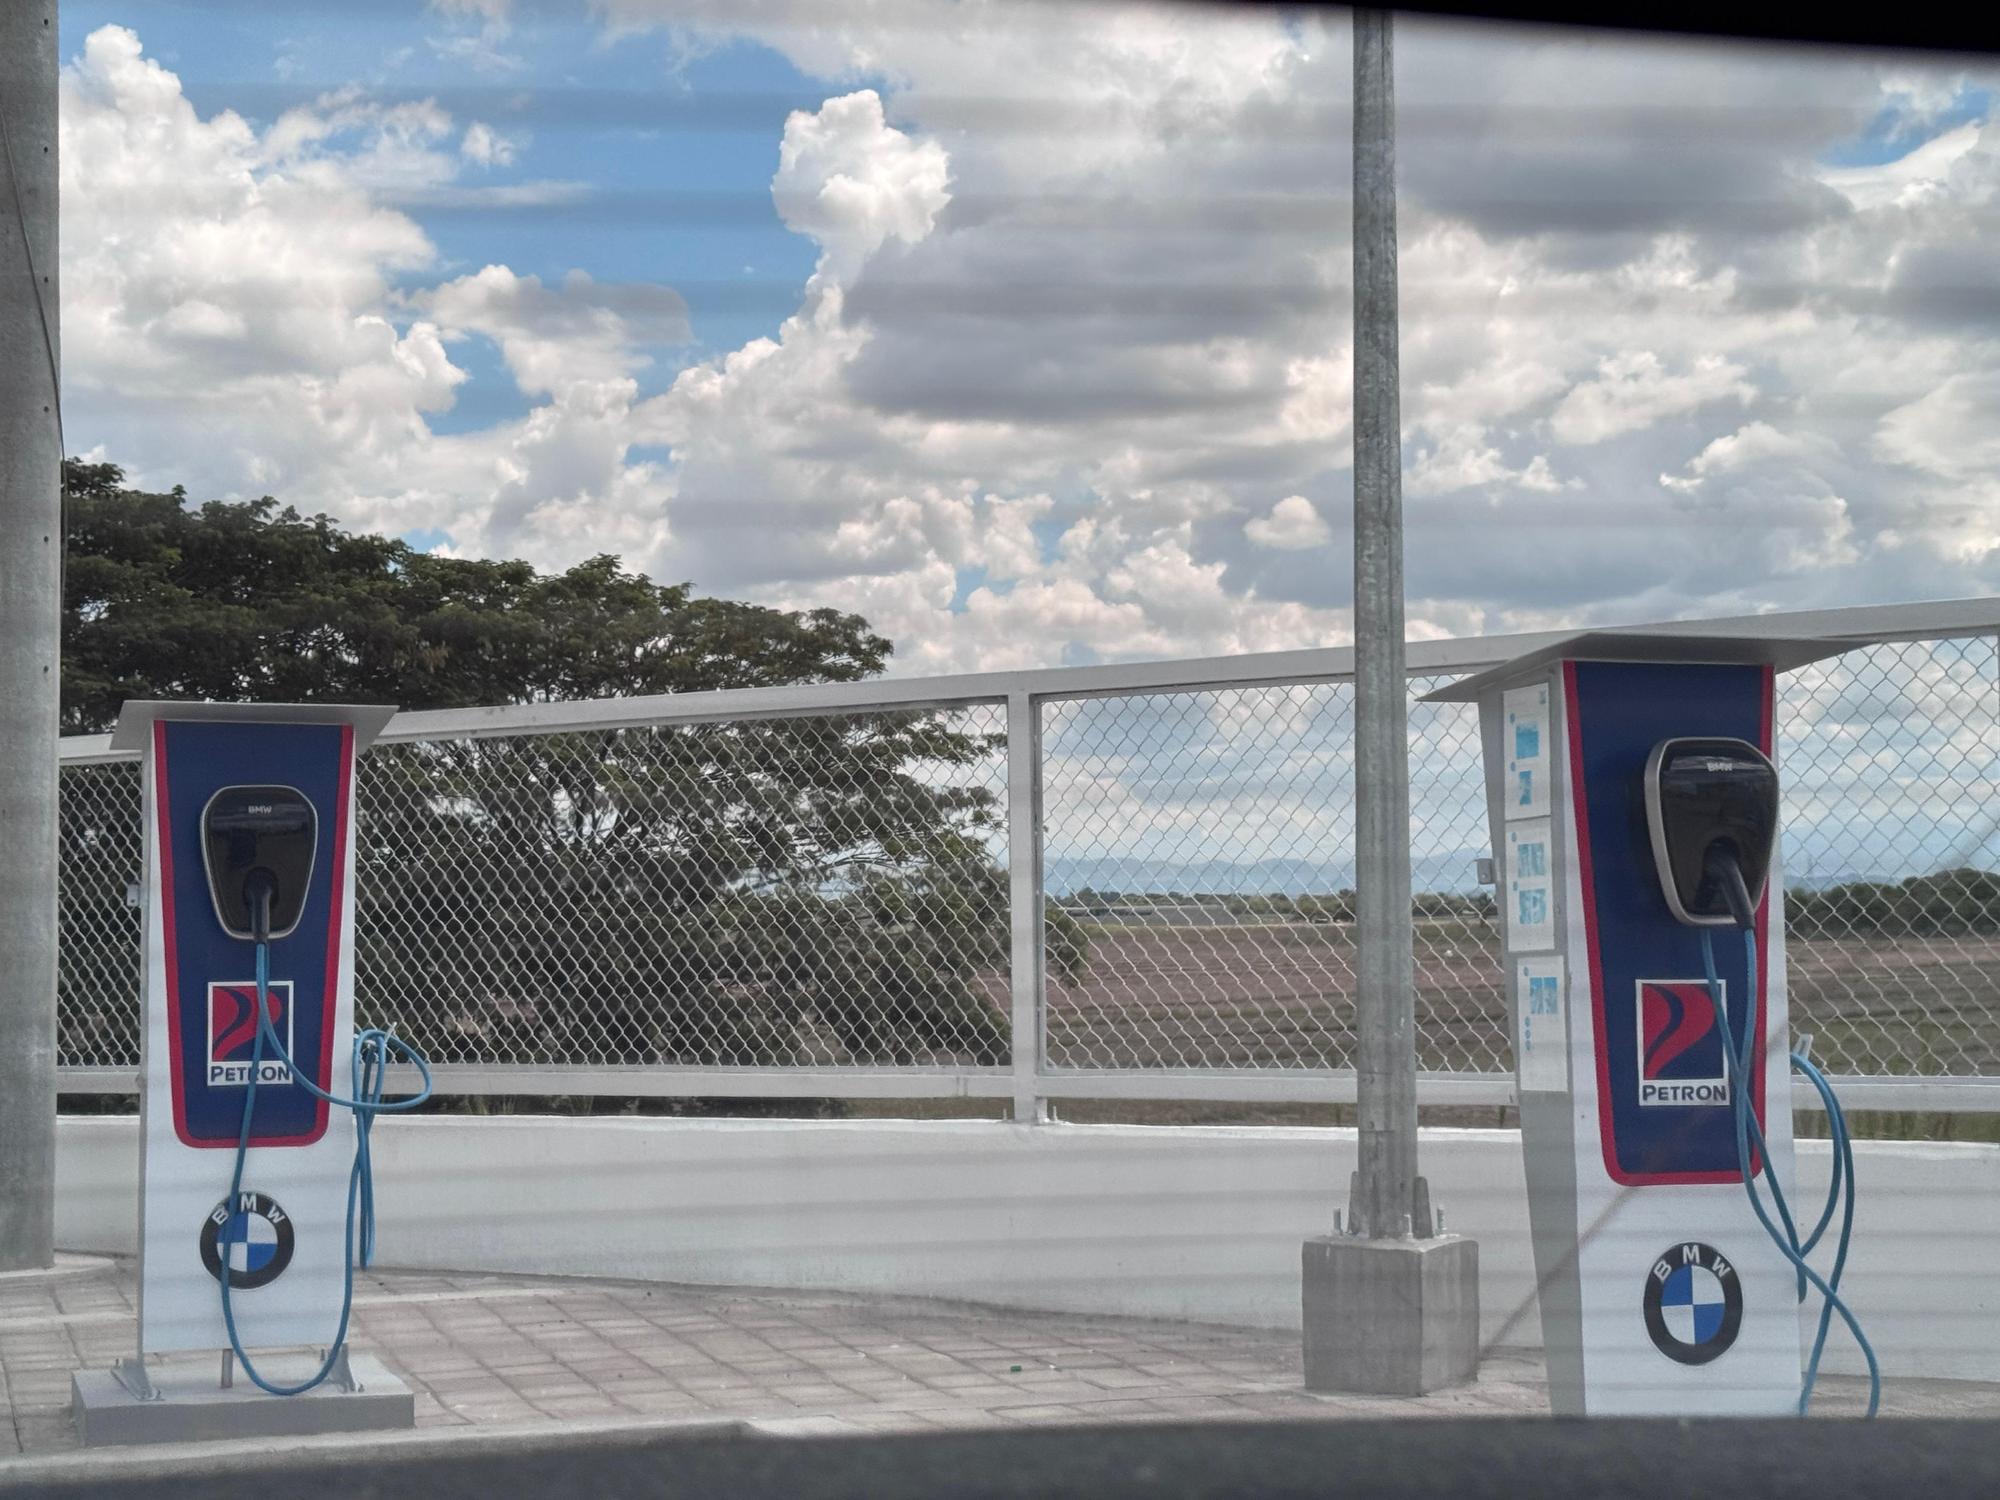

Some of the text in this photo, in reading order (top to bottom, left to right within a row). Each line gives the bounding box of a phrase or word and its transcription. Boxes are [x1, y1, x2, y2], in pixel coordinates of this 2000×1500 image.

[1707, 762, 1733, 771] BMW
[248, 805, 272, 814] BMW
[1642, 1084, 1727, 1101] PETRON
[212, 1193, 286, 1225] BMW
[1653, 1244, 1731, 1281] BMW
